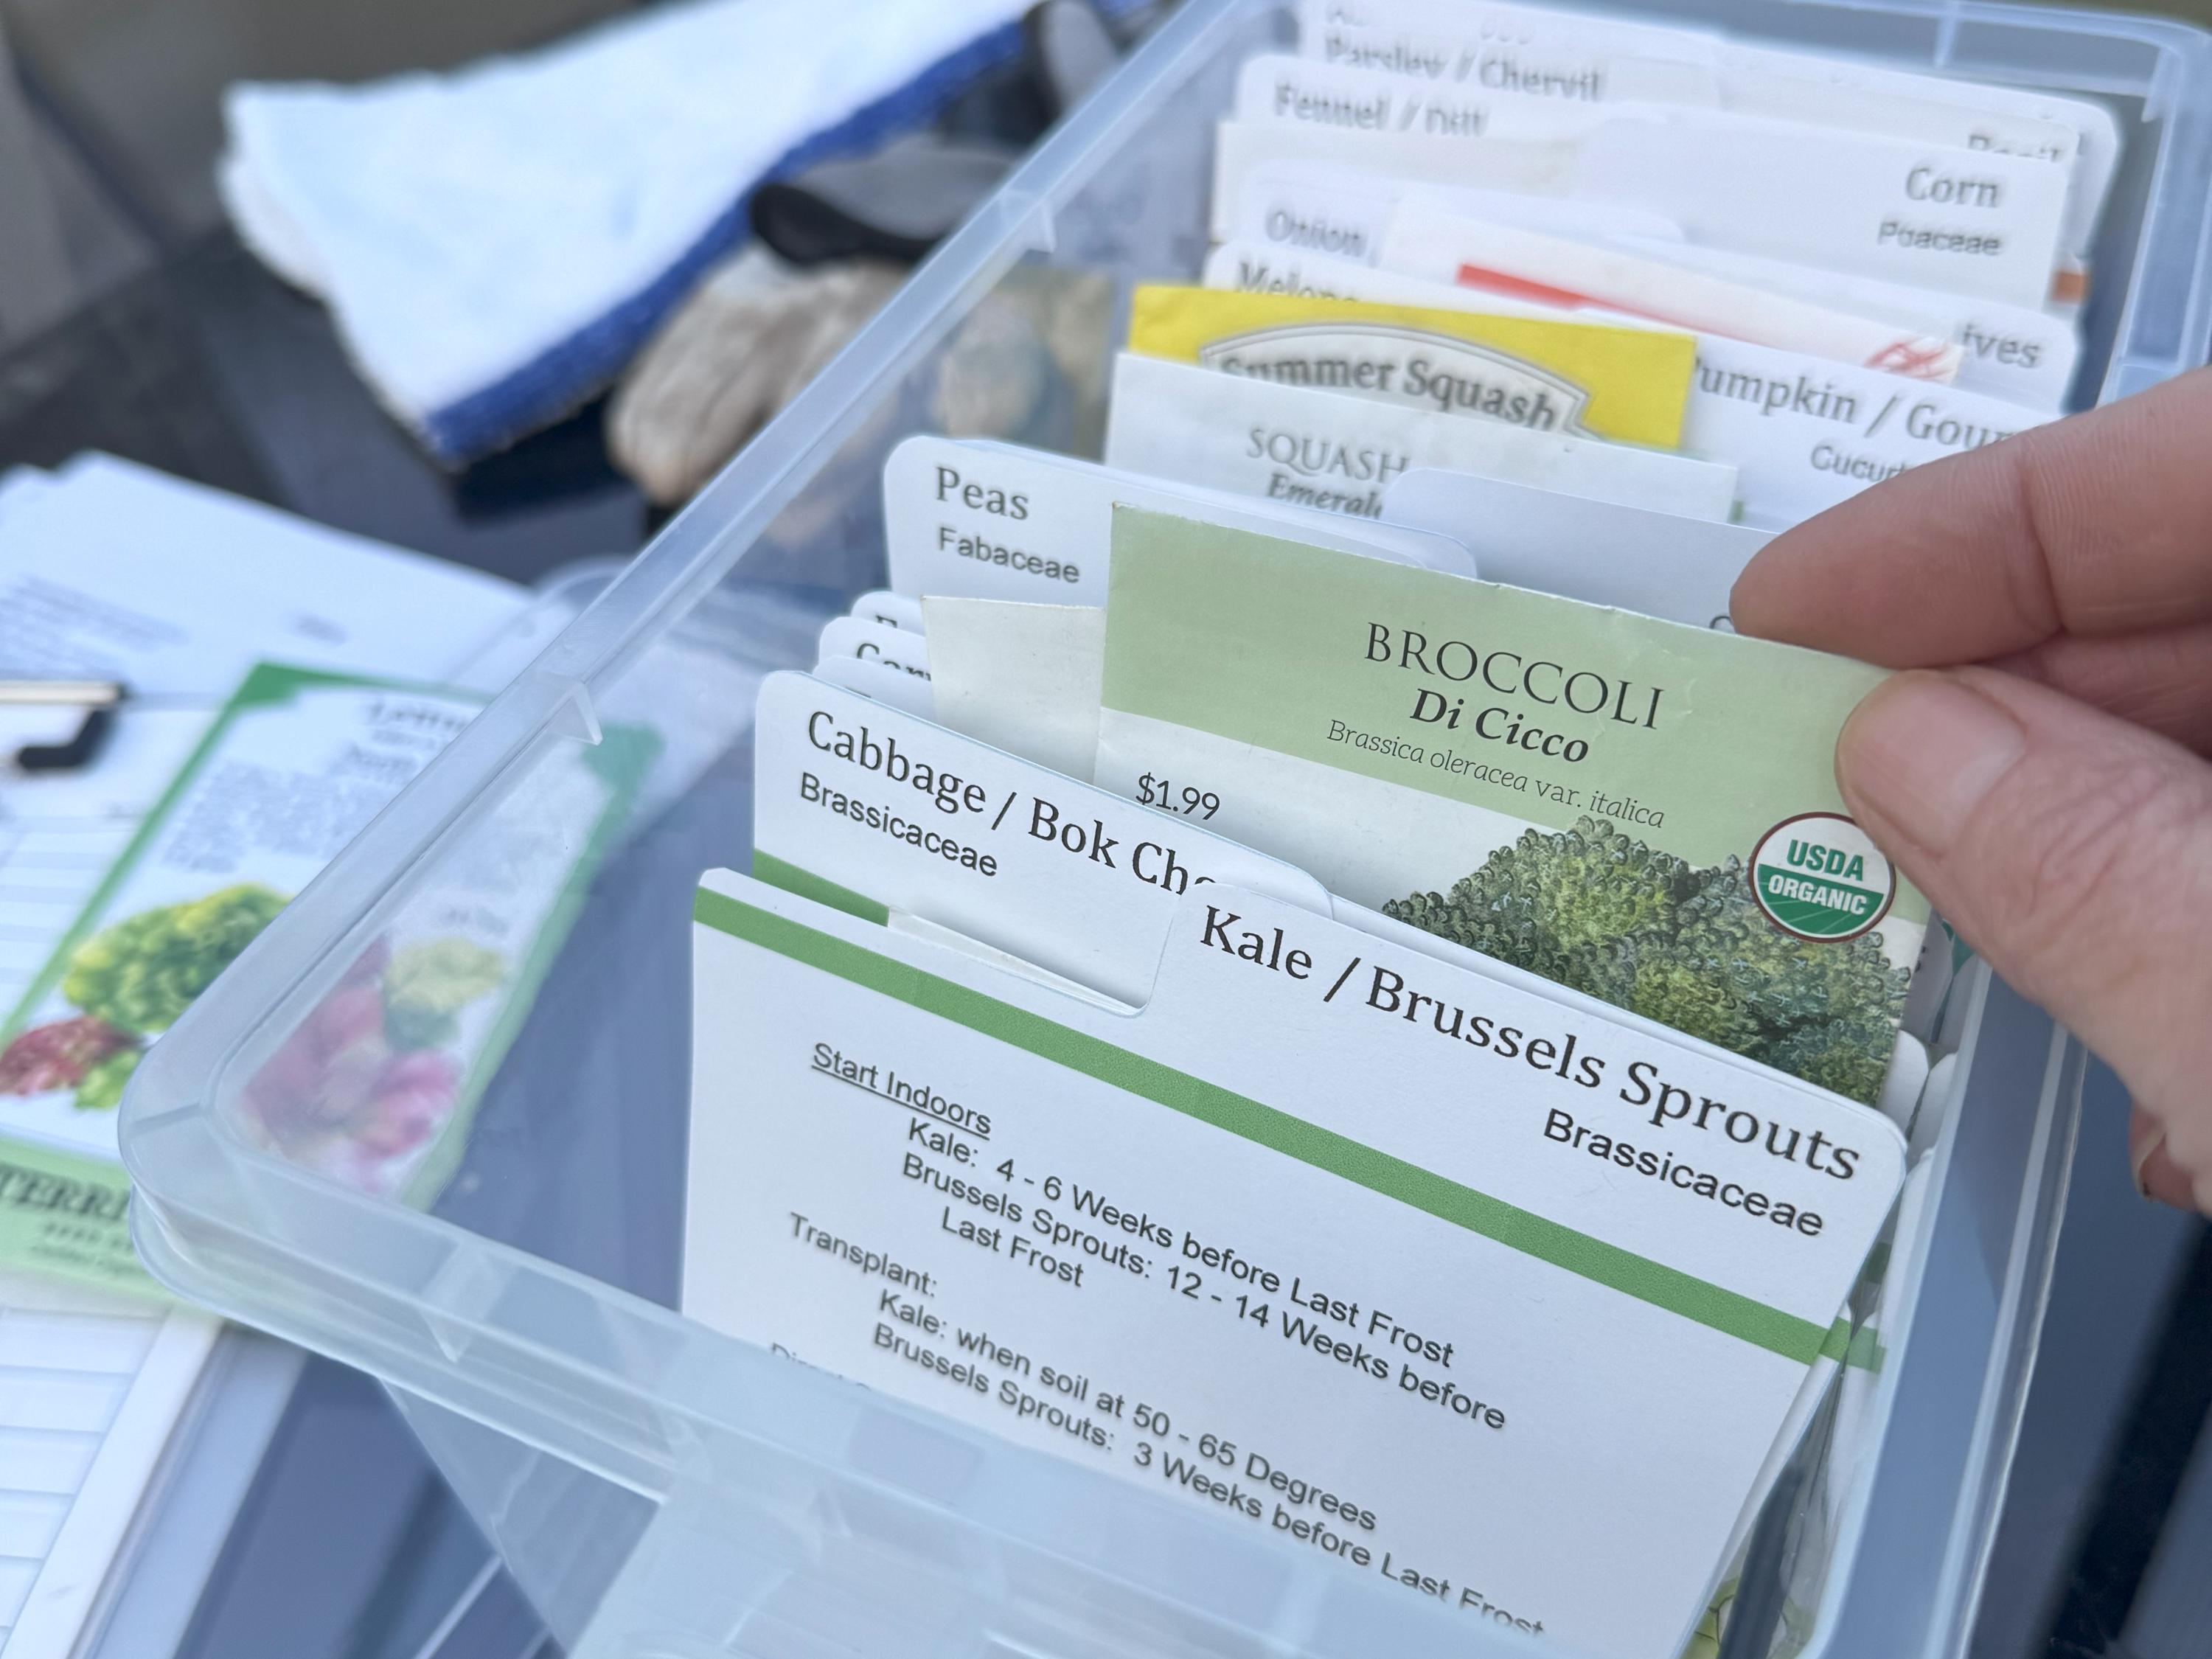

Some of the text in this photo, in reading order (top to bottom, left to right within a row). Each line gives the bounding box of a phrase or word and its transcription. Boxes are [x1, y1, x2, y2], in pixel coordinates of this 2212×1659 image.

[1274, 81, 1388, 130] Fennel
[1479, 52, 1607, 101] Chervil
[1905, 166, 2000, 209] Corn
[1266, 209, 1368, 257] Onion
[1877, 220, 2003, 257] Poaceae
[1402, 358, 1557, 431] Squash
[1695, 356, 1857, 424] umpkin
[1245, 426, 1411, 484] SQUASH
[935, 465, 1029, 519] Peas
[939, 527, 1080, 583] Fabaceae
[1364, 621, 1666, 729] BROCCOLI
[1410, 689, 1589, 762] Di Cicco
[809, 711, 1217, 896] Cabbage / Bok Ch
[1135, 772, 1220, 820] $1.99
[1327, 719, 1666, 829] Brassica oleracea var. italica
[801, 771, 998, 877] Brassicaceae
[1787, 839, 1863, 881] USDA
[1768, 874, 1868, 916] ORGANIC
[1200, 905, 1860, 1180] Kale / Brussels Sprouts
[813, 1042, 992, 1137] Start Indoors
[1543, 1107, 1823, 1237] Brassicaceae
[790, 1211, 937, 1298] Transplant:
[908, 1117, 978, 1167] Kale:
[996, 1158, 1015, 1183] 4
[1044, 1175, 1062, 1200] 6
[1072, 1183, 1173, 1248] Weeks
[1182, 1231, 1281, 1293] before
[1290, 1277, 1360, 1328] Last
[1367, 1310, 1454, 1368] Frost
[942, 1206, 1085, 1287] Last Frost
[902, 1152, 1023, 1222] Brussels
[1032, 1208, 1153, 1279] Sprouts:
[1167, 1265, 1203, 1299] 12
[1235, 1294, 1270, 1328] 14
[1281, 1310, 1389, 1380] Weeks
[1398, 1363, 1506, 1430] before
[879, 1288, 947, 1338] Kale:
[957, 1326, 1031, 1376] when
[1040, 1365, 1088, 1401] soil
[1096, 1391, 1124, 1419] at
[1133, 1402, 1170, 1438] 50
[1197, 1433, 1237, 1467] 65
[1245, 1452, 1377, 1531] Degrees
[873, 1322, 990, 1394] Brussels
[998, 1380, 1116, 1451] Sprouts:
[1134, 1441, 1152, 1467] 3
[1162, 1451, 1262, 1519] Weeks
[1271, 1503, 1372, 1567] before
[1380, 1551, 1450, 1602] Last
